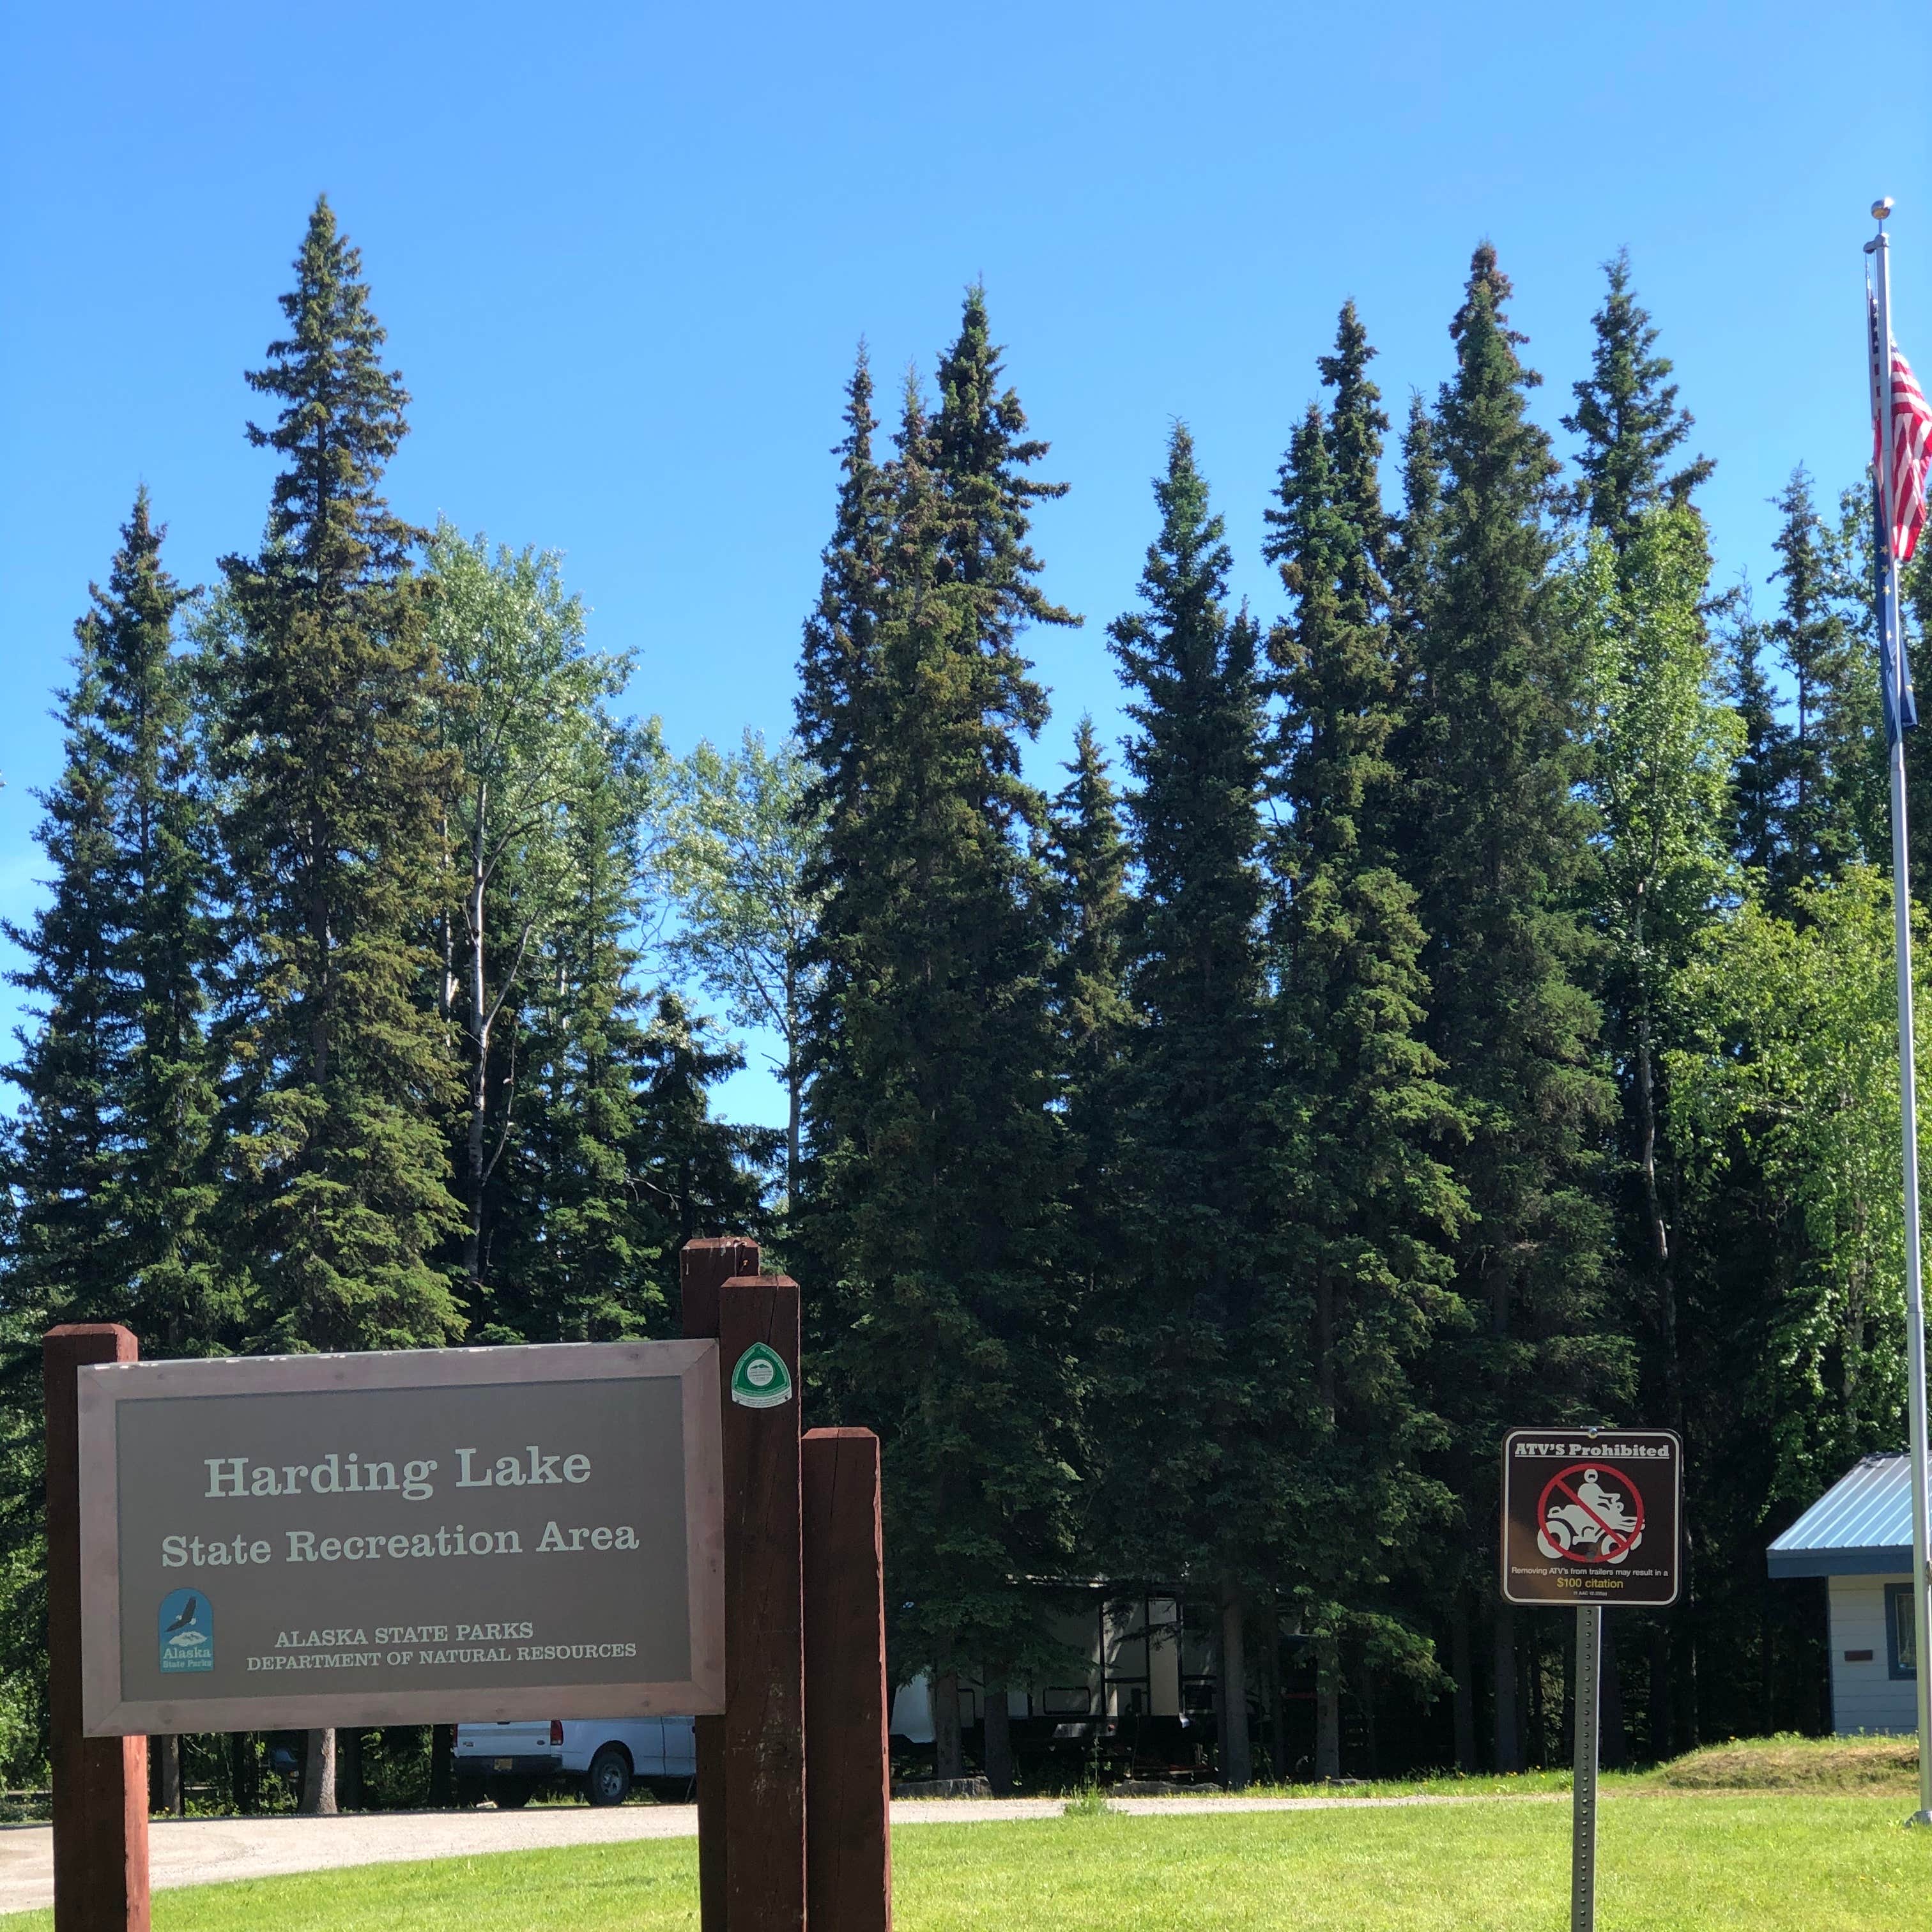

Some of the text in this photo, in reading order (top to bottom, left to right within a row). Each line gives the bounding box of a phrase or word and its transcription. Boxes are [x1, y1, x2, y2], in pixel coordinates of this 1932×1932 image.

[1515, 1443, 1669, 1457] ATV'S Prohibited
[204, 1445, 591, 1501] Harding Lake
[161, 1521, 640, 1567] State Recreation Area
[1512, 1567, 1547, 1575] Removing
[1584, 1578, 1623, 1588] citation
[275, 1621, 533, 1648] ALASKA STATE PARKS
[163, 1646, 211, 1659] Alaska
[246, 1643, 637, 1671] DEPARTMENT OF NATURAL RESOURCES
